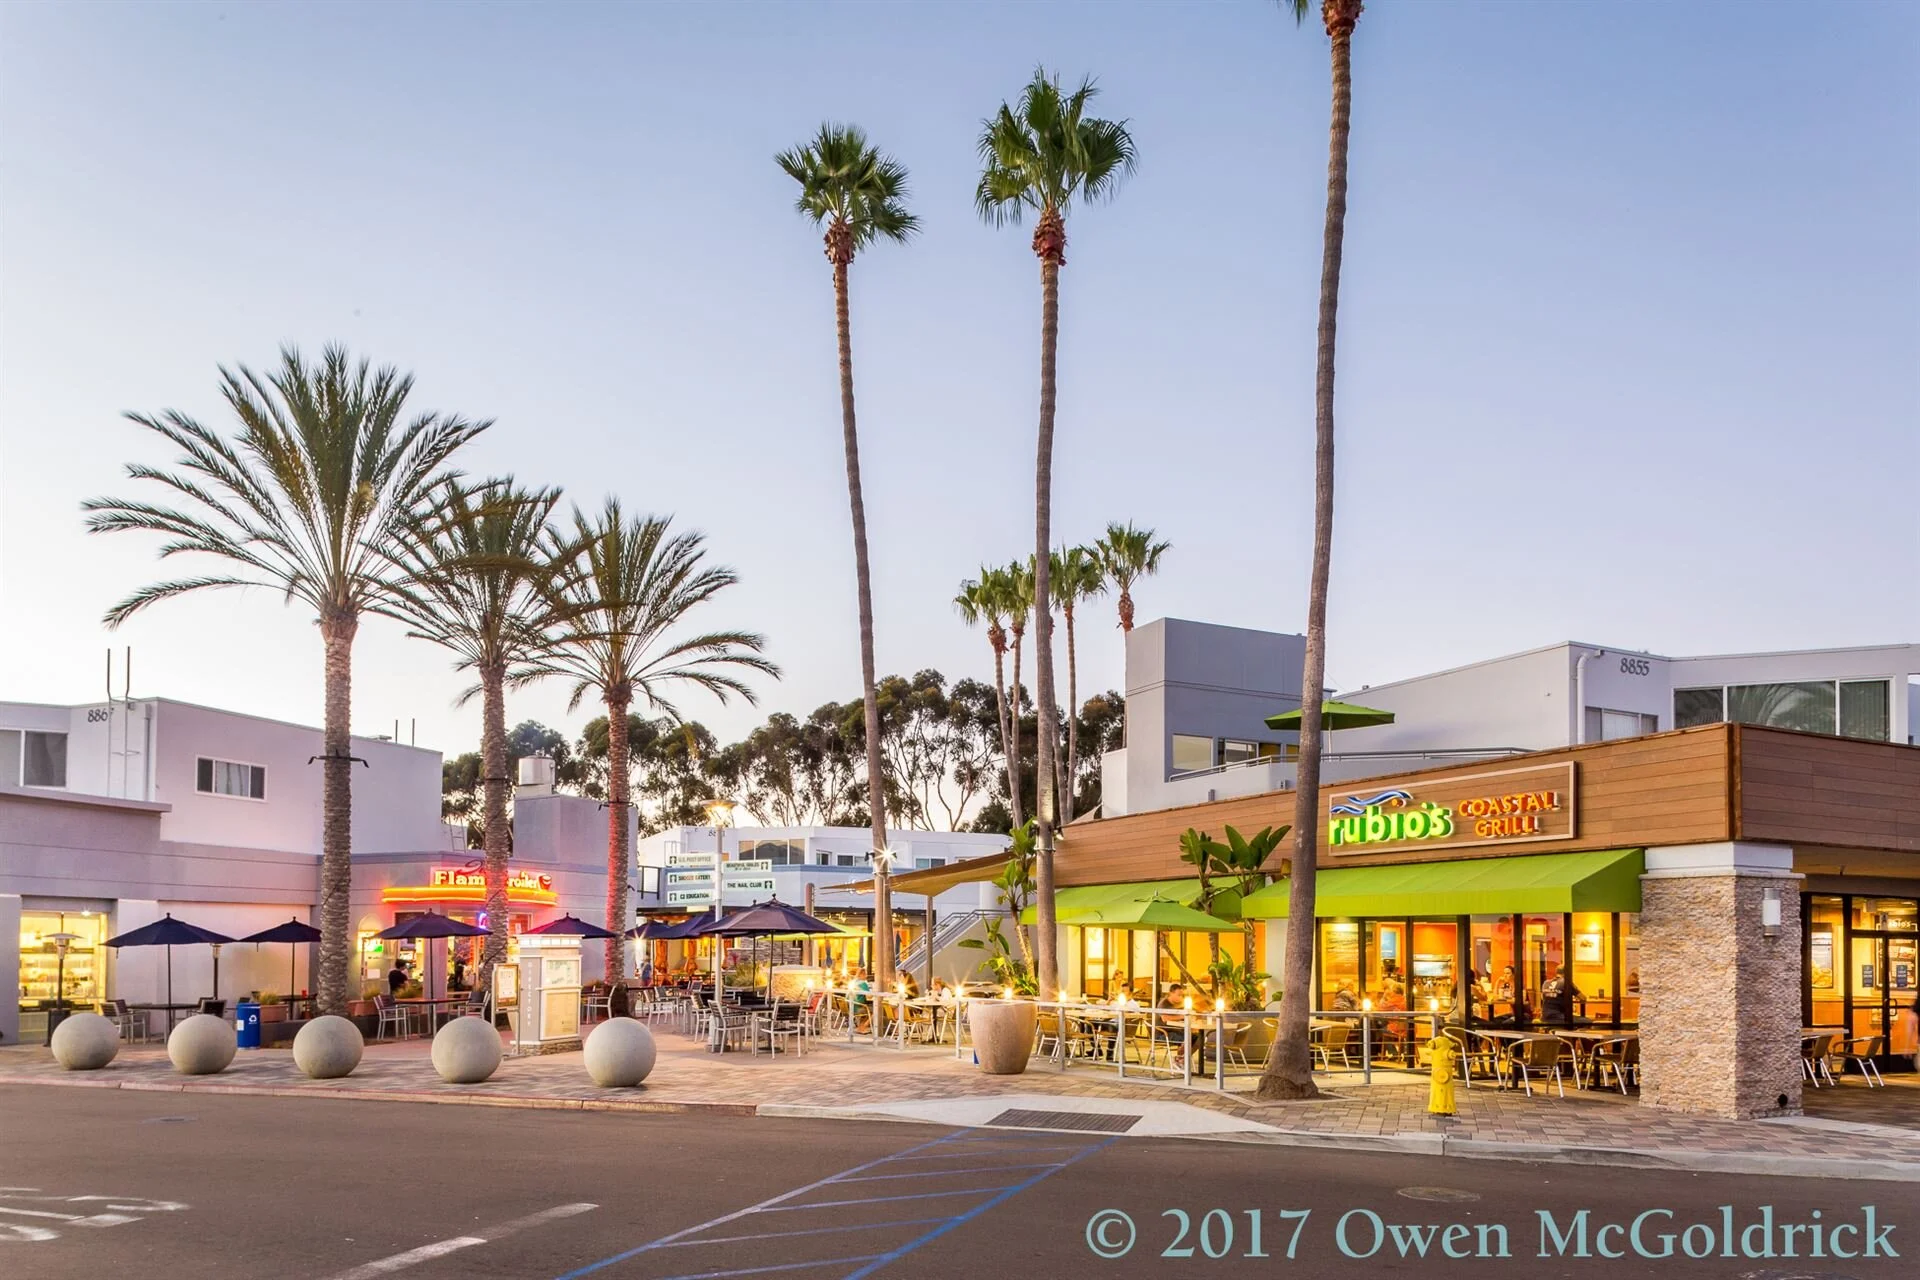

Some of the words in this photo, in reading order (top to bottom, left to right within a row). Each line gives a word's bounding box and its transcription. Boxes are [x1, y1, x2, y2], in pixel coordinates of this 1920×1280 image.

[1620, 658, 1650, 676] 8855
[1458, 791, 1561, 818] COASTAL
[1328, 803, 1454, 845] rubio's
[1475, 815, 1541, 838] GRILL
[434, 869, 485, 886] Flam
[506, 869, 538, 889] roiler
